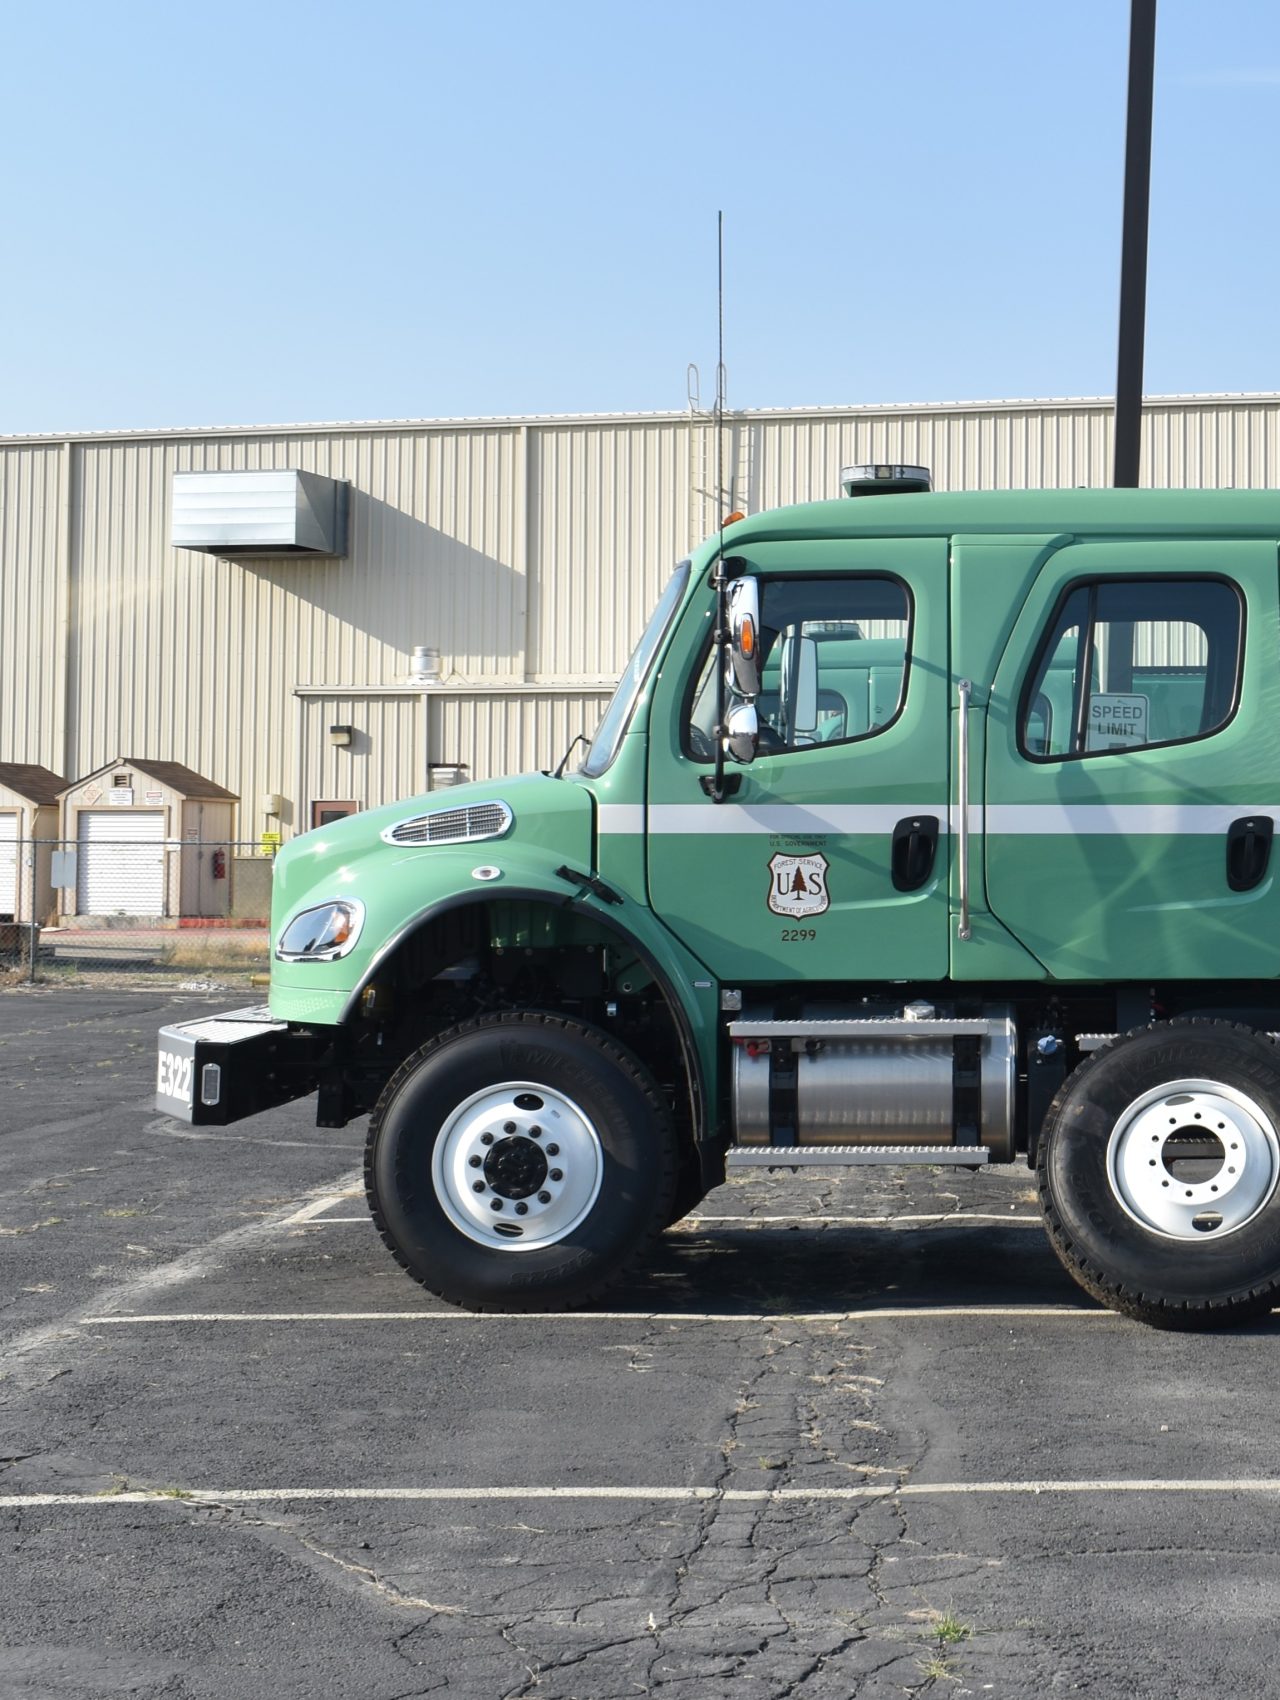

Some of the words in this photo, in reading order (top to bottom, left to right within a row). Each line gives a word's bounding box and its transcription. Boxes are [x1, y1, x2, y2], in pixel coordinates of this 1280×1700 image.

[1092, 705, 1143, 719] SPEED
[1097, 722, 1137, 736] LIMIT
[774, 858, 797, 870] FOREST
[798, 858, 824, 871] SERVICE
[781, 929, 817, 942] 2299
[157, 1049, 192, 1103] E322
